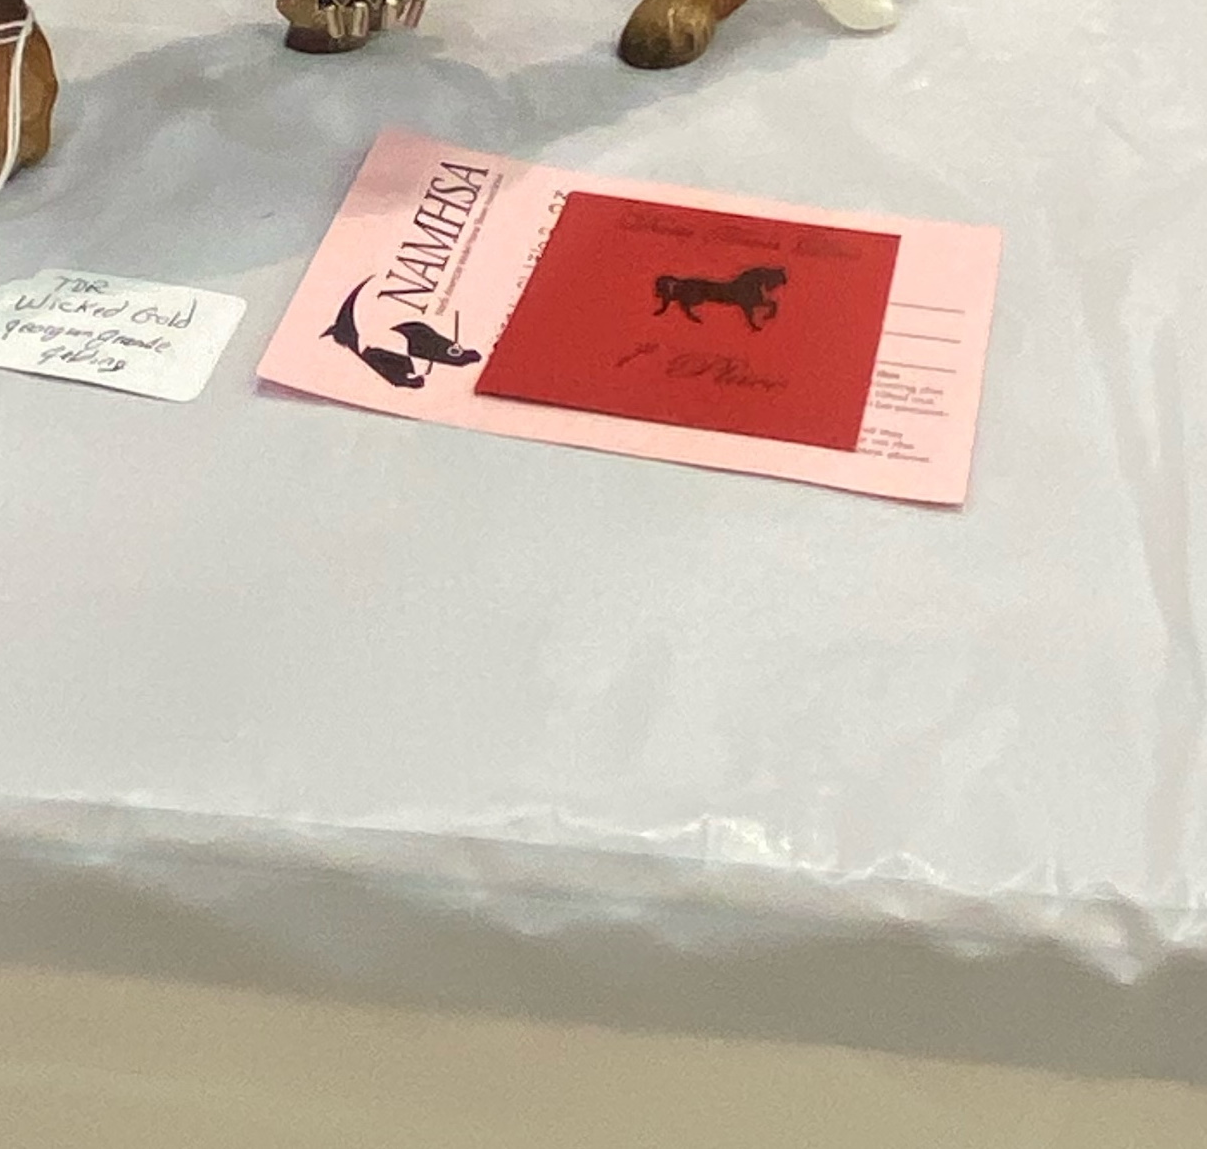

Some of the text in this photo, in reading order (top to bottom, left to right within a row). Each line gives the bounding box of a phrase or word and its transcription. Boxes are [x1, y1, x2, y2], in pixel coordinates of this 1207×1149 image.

[377, 161, 490, 316] NAMHSA
[54, 275, 109, 294] TDR
[14, 293, 198, 329] Wicked Gold
